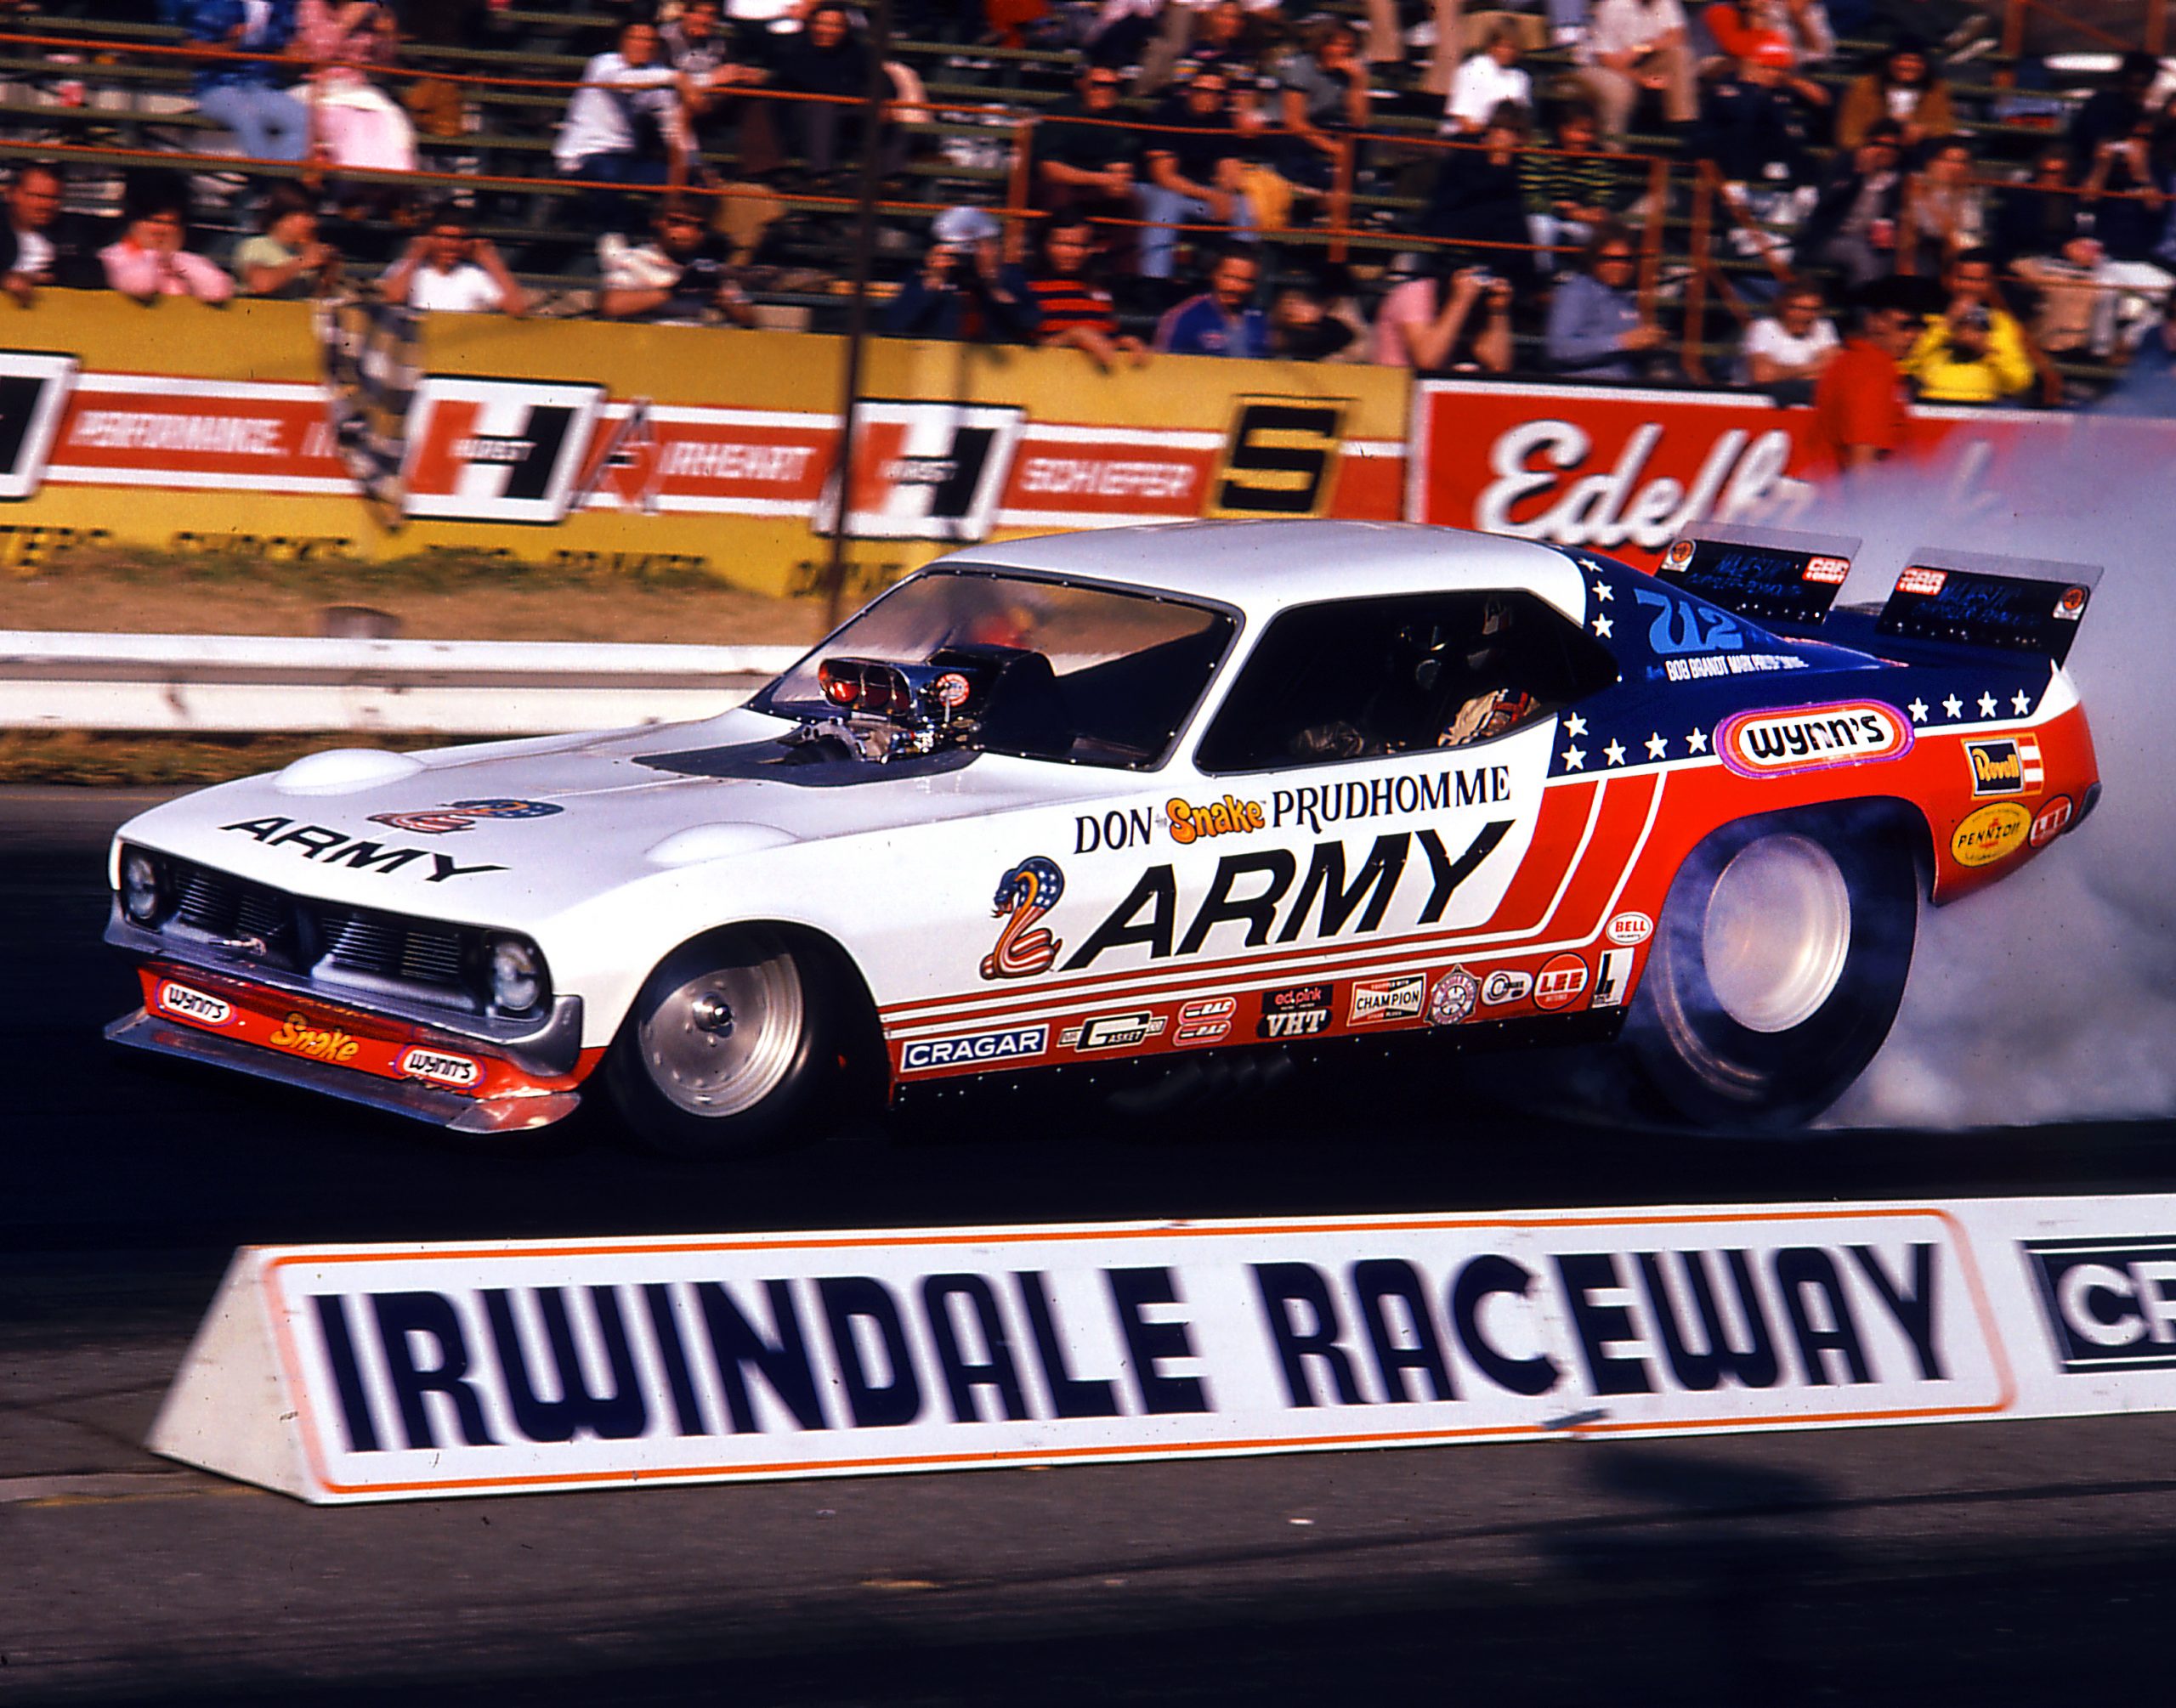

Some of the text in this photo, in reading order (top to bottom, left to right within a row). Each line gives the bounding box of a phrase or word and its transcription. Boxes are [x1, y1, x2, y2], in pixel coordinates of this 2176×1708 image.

[1221, 404, 1338, 512] S
[1665, 659, 1692, 682] BOB
[1688, 655, 1729, 679] BRANDT
[1971, 748, 2021, 782] Revell
[1073, 806, 1153, 856] DON
[1165, 794, 1266, 846] Snake
[1272, 766, 1512, 835] PRUDHOMME
[218, 817, 512, 883] ARMY
[1057, 818, 1517, 973] ARMY
[1615, 920, 1646, 932] BELL
[1539, 970, 1584, 993] LEE
[1356, 989, 1420, 1010] CHAMPION
[269, 1011, 360, 1061] Snake
[1266, 1009, 1328, 1038] VHT
[908, 1032, 1040, 1066] CRAGAR
[309, 1241, 1949, 1453] IRWINDALE RACEWAY
